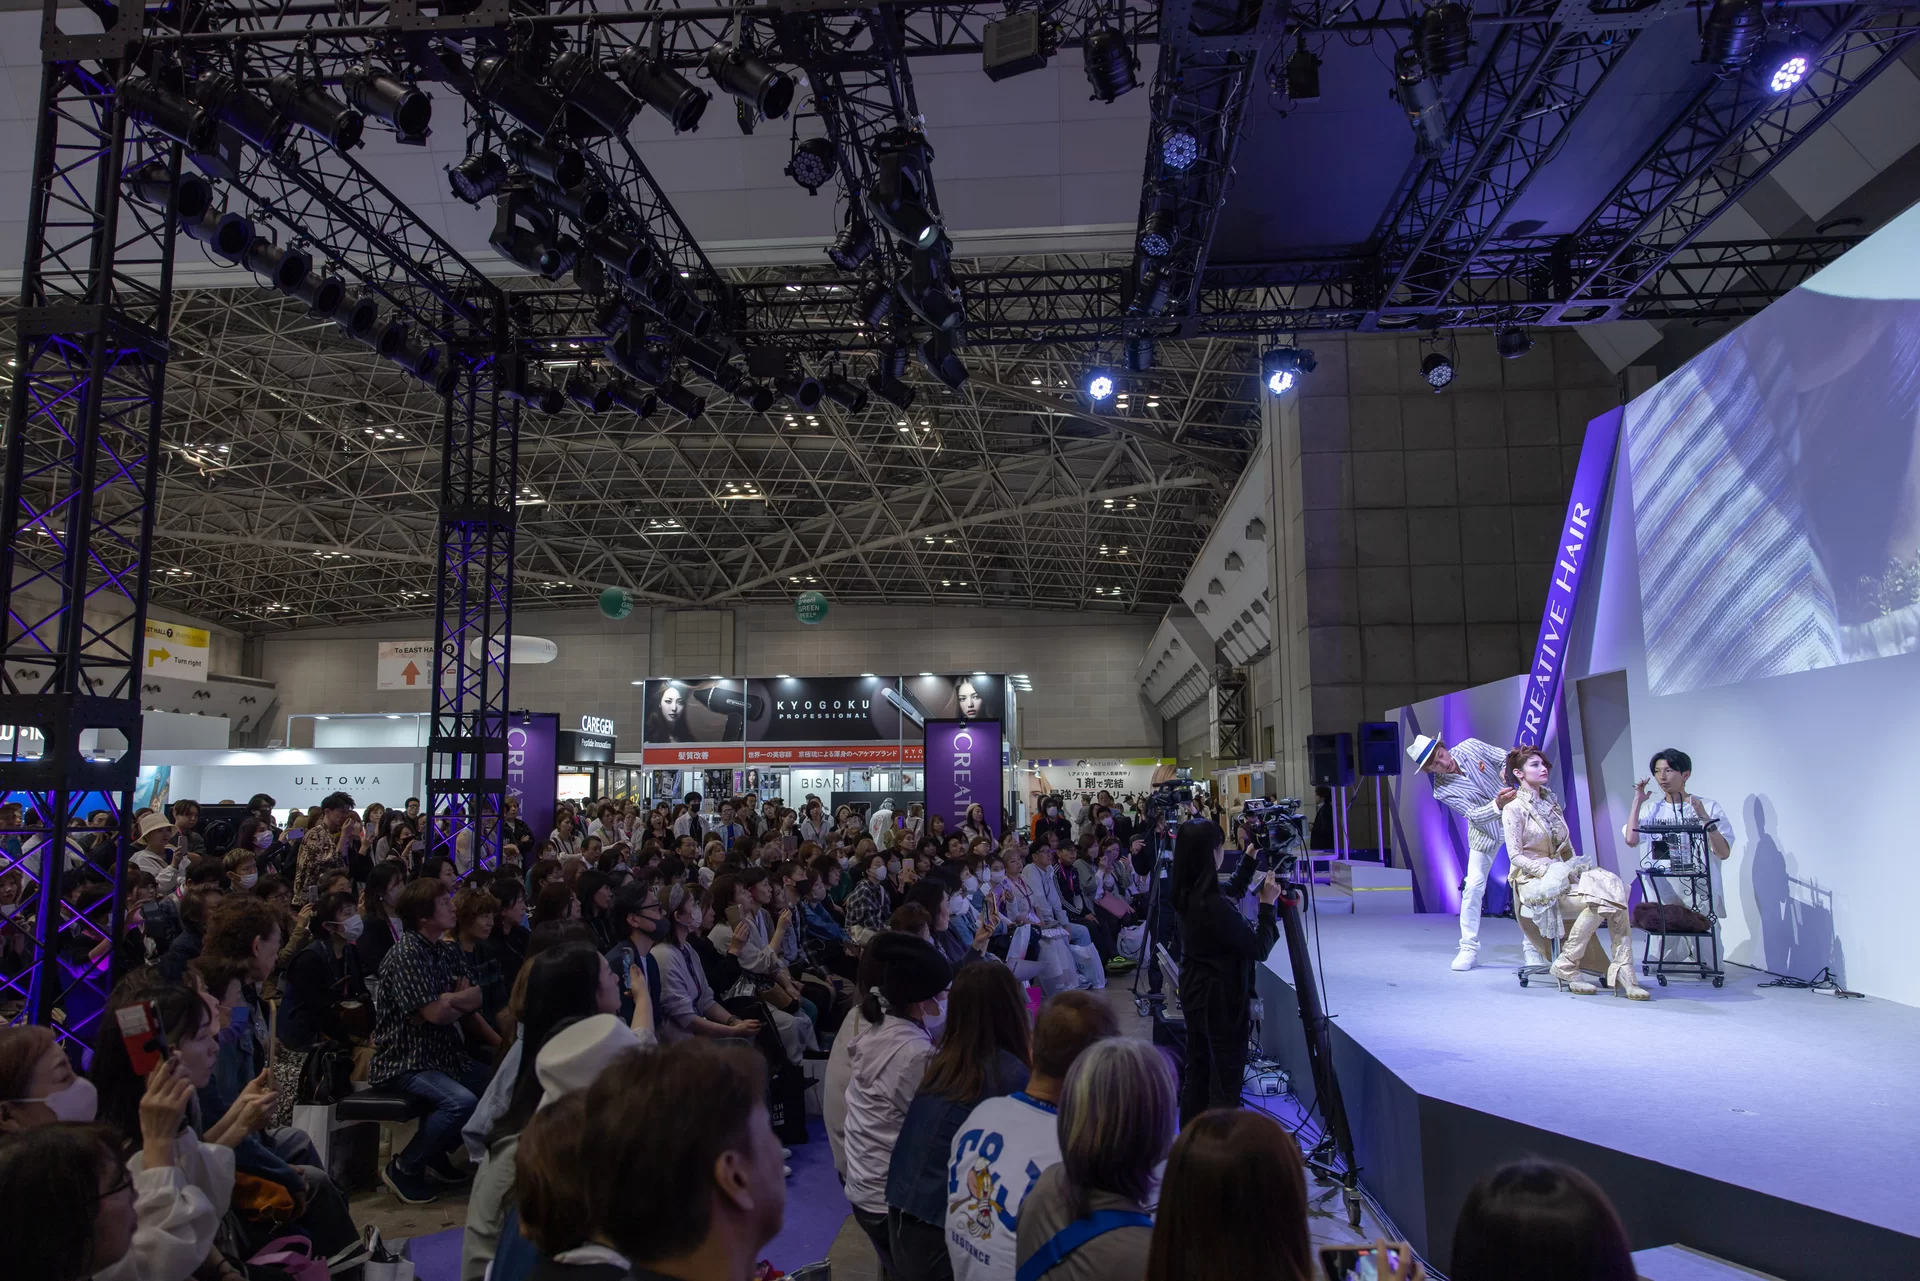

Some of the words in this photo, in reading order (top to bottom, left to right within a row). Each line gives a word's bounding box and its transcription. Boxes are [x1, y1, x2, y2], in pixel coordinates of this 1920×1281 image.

[1519, 599, 1567, 747] CREATIVE
[1555, 501, 1591, 593] HAIR
[174, 656, 187, 664] Turn
[188, 659, 202, 667] right
[777, 700, 869, 710] KYOGOKU
[581, 715, 614, 735] CAREGEN
[678, 751, 709, 760] 髪質改善
[295, 776, 380, 785] ULTOWA
[951, 1230, 991, 1266] SEQUENCE
